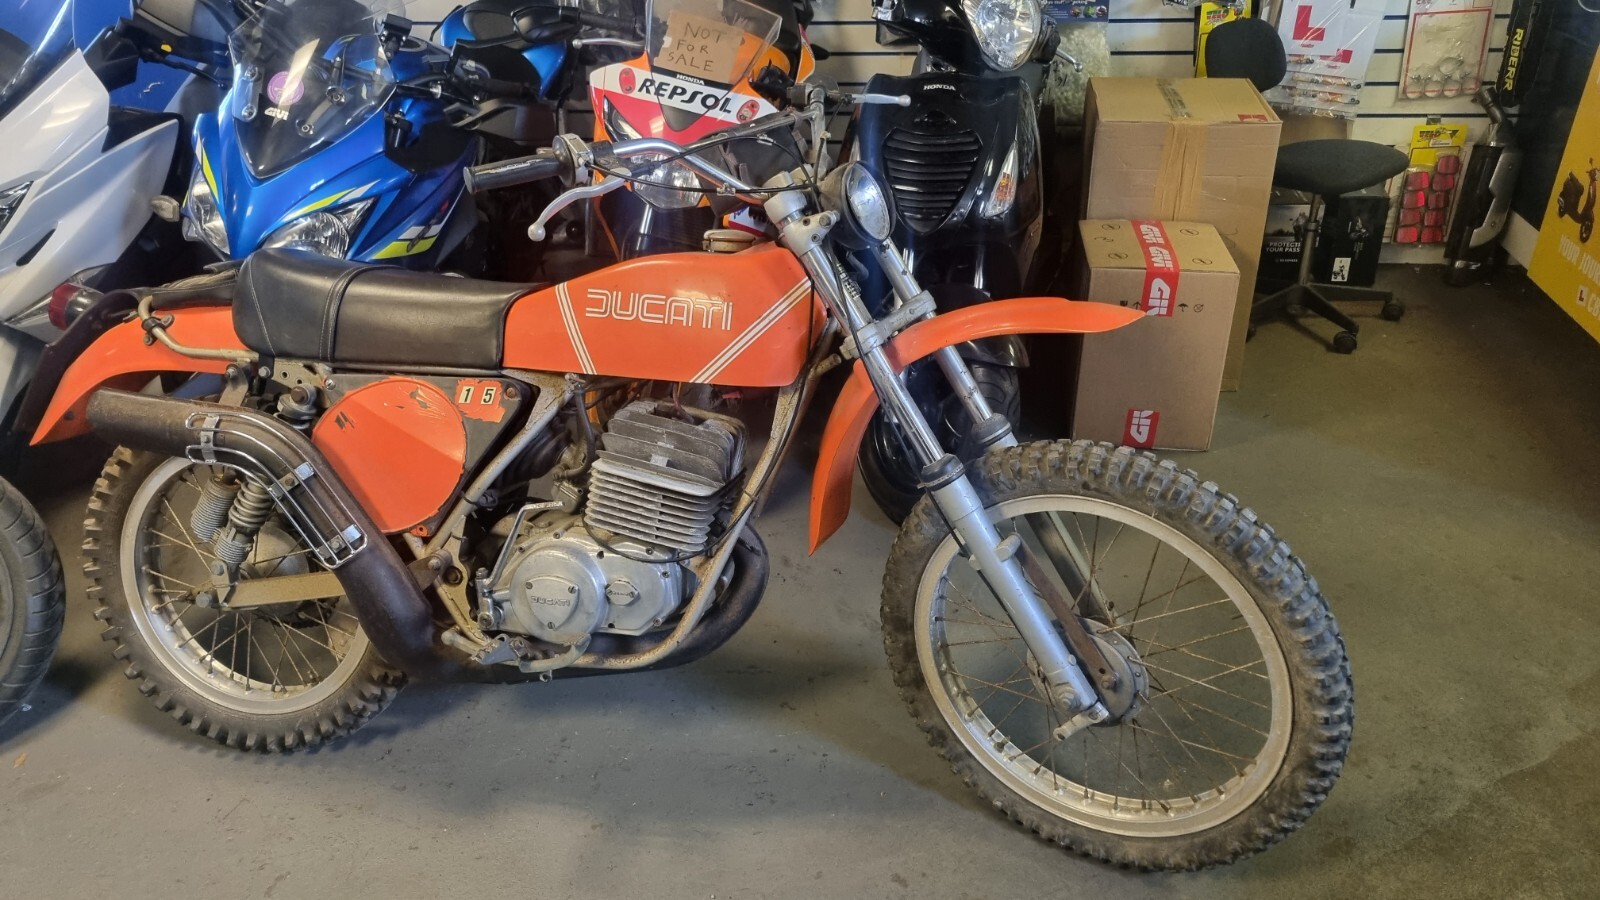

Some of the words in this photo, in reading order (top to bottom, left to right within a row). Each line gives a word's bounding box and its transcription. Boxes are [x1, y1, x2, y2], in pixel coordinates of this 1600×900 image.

[684, 22, 727, 44] NOT
[677, 39, 709, 54] FOR
[667, 51, 714, 72] SALE
[1503, 28, 1524, 91] RIDERR
[676, 73, 705, 86] HONDA
[637, 78, 732, 114] REPSOL
[264, 107, 289, 120] GIVI
[1140, 224, 1165, 244] GIVI
[1148, 246, 1174, 268] GIVI
[585, 288, 733, 331] DUCATI
[530, 595, 571, 607] DUCATI
